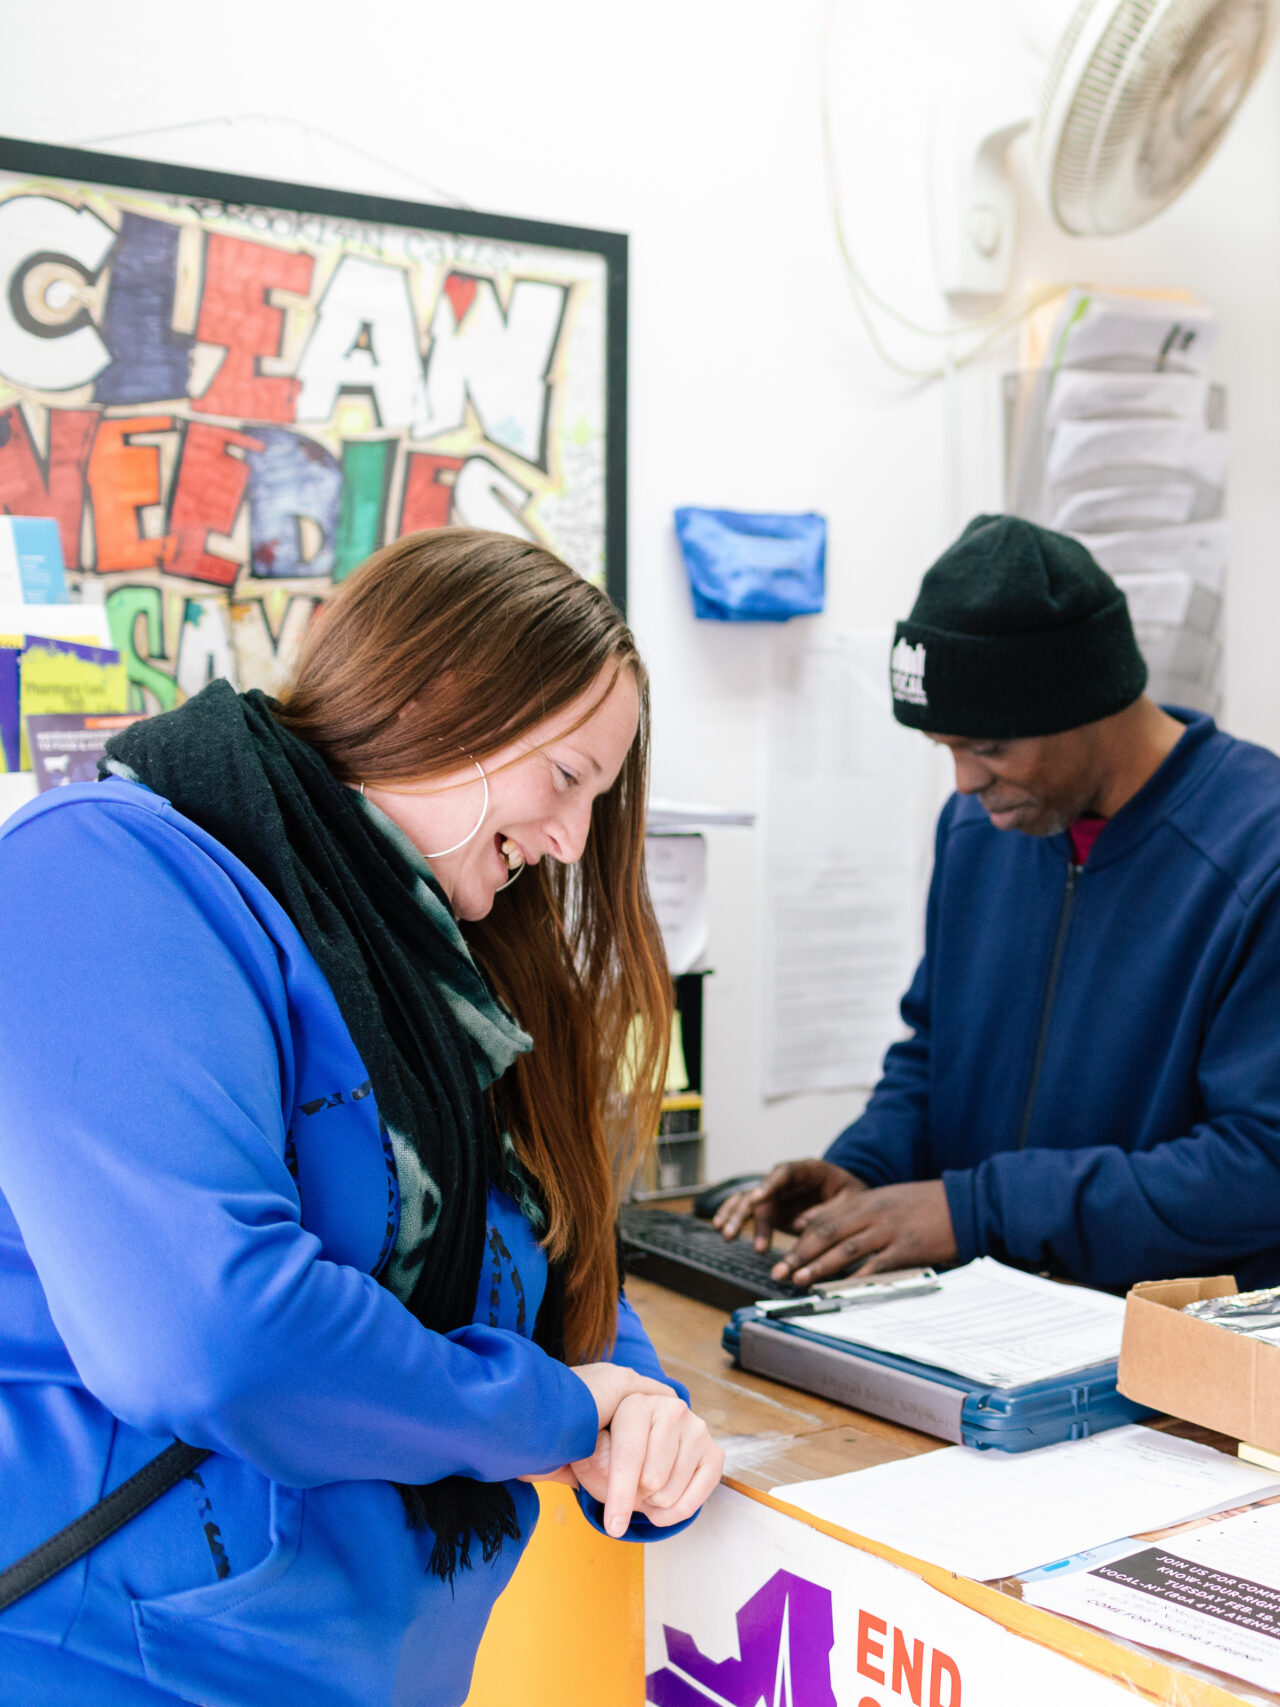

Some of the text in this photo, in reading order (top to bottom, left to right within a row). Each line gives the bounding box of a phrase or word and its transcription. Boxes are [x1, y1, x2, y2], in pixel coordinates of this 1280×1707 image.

[0, 195, 571, 472] CLEAN
[105, 583, 322, 715] SAV
[1099, 1567, 1166, 1592] VOCAL-NY
[1196, 1603, 1225, 1614] 4TH
[1156, 1556, 1189, 1569] JOIN
[1189, 1567, 1209, 1575] US
[1208, 1574, 1237, 1585] FOR
[1164, 1580, 1226, 1602] TUESDAY
[1224, 1601, 1252, 1614] FEB.
[857, 1608, 961, 1707] END
